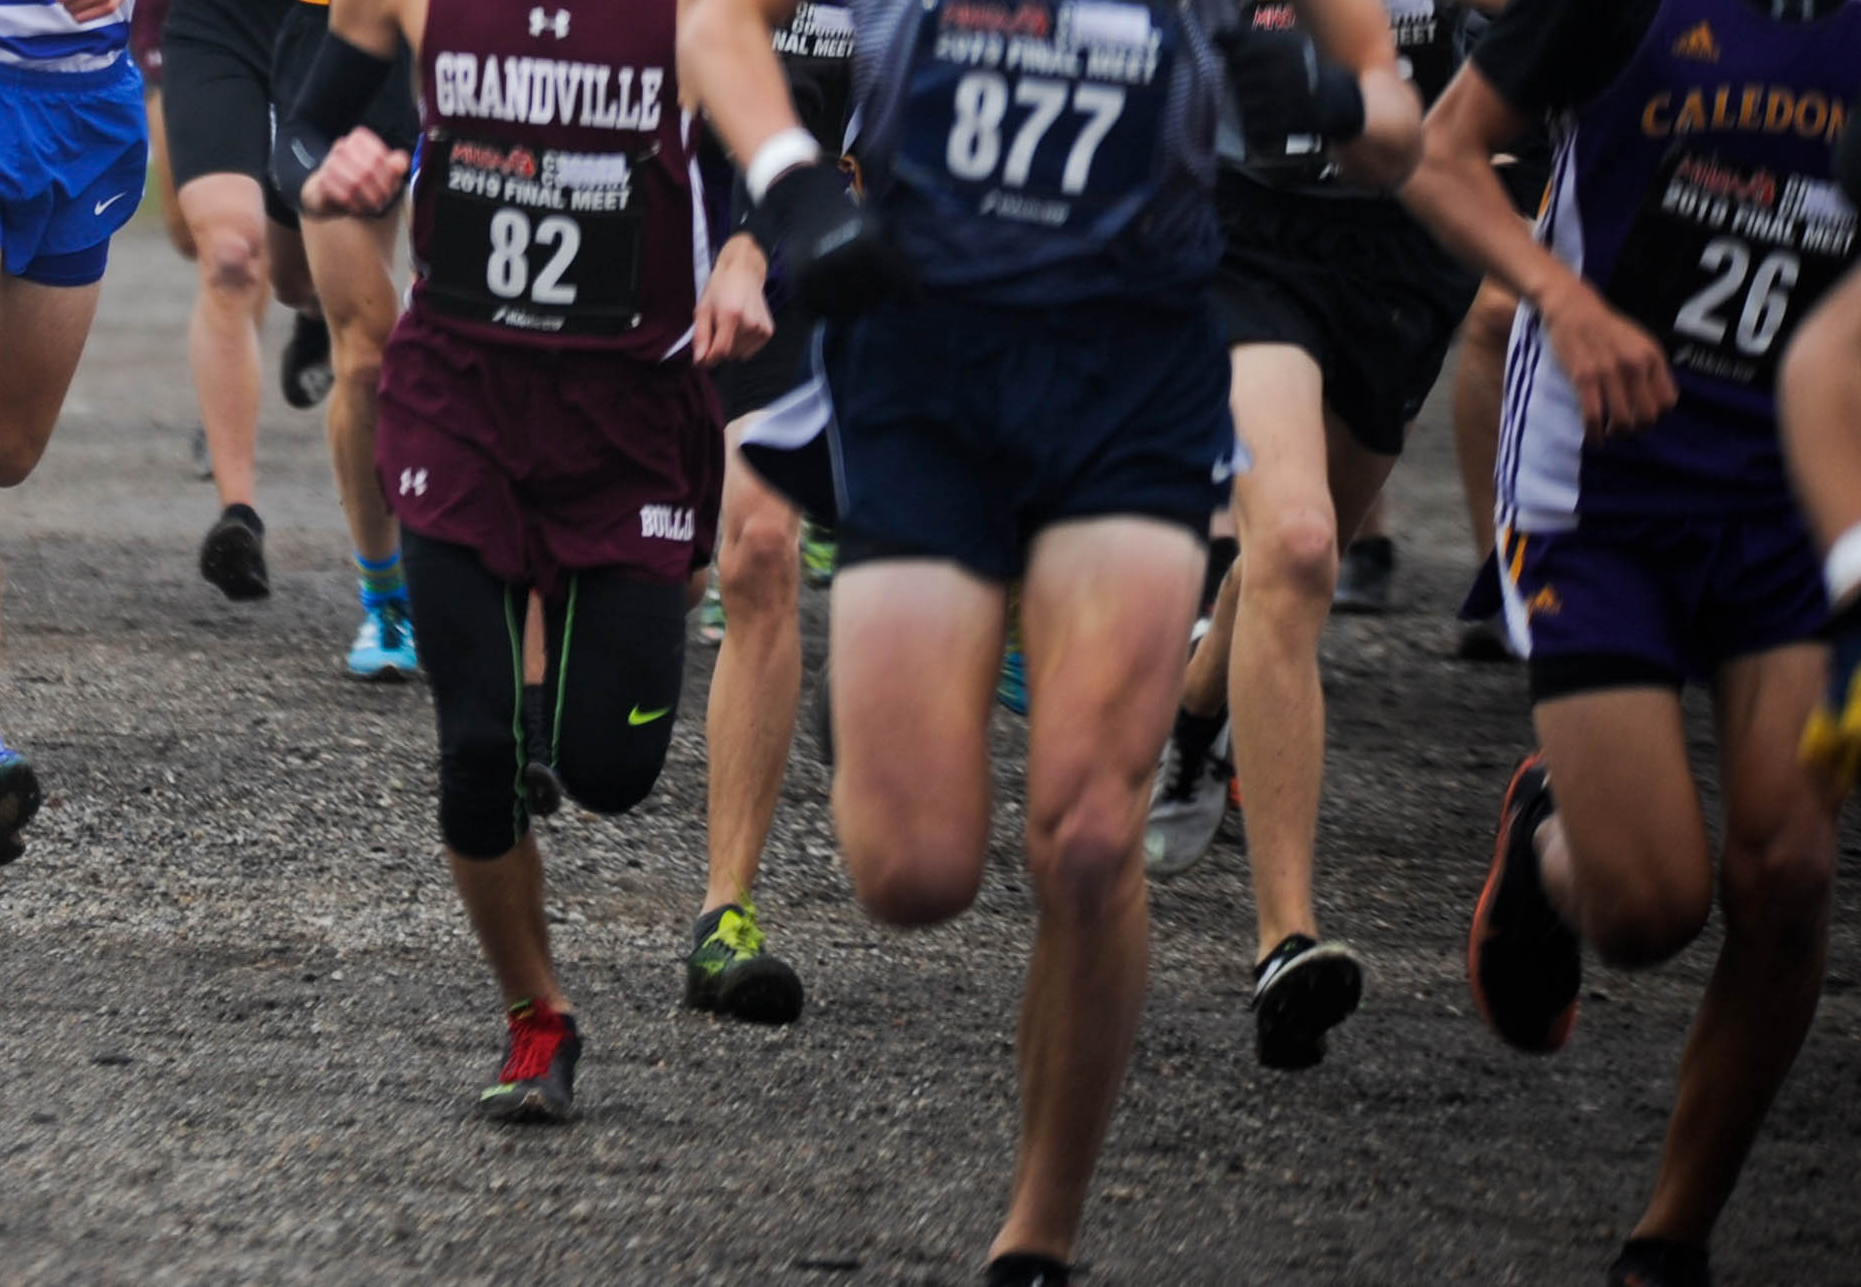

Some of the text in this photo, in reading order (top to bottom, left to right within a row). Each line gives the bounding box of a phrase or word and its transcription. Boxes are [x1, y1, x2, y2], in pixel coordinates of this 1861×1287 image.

[1388, 19, 1438, 46] EET
[435, 50, 664, 132] GRANDVILLE
[945, 69, 1127, 196] 877
[447, 167, 632, 212] 2019 FINAL MEET
[487, 206, 582, 305] 82
[1672, 235, 1802, 357] 26
